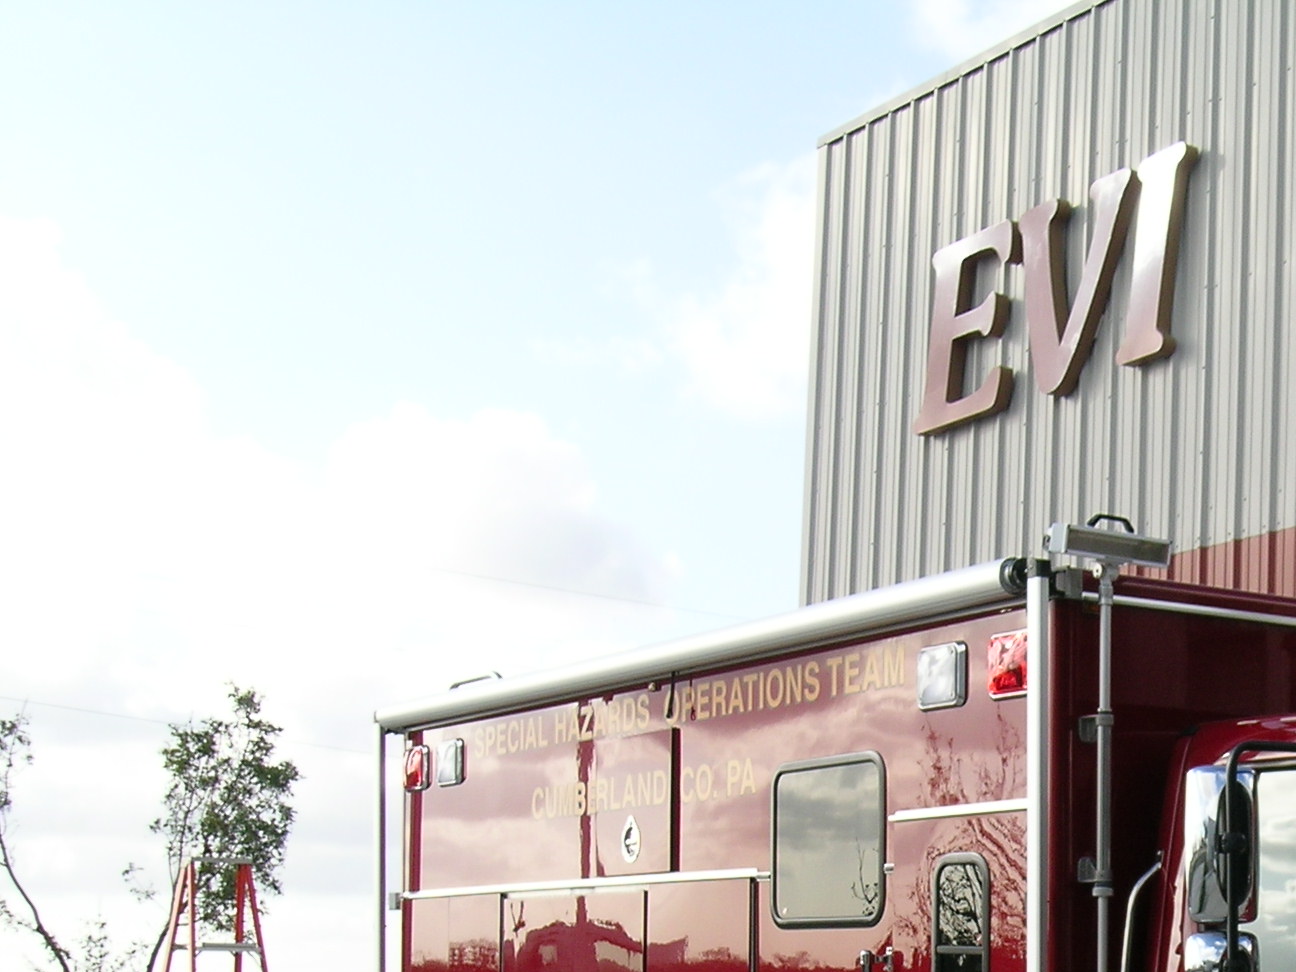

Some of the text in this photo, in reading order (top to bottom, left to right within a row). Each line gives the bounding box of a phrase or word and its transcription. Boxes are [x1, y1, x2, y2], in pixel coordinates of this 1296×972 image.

[912, 140, 1198, 437] EVI
[474, 643, 906, 758] SPECIAL HAZARDS OPERATIONS TEAM
[531, 758, 757, 819] CUMBERLAND CO. PA
